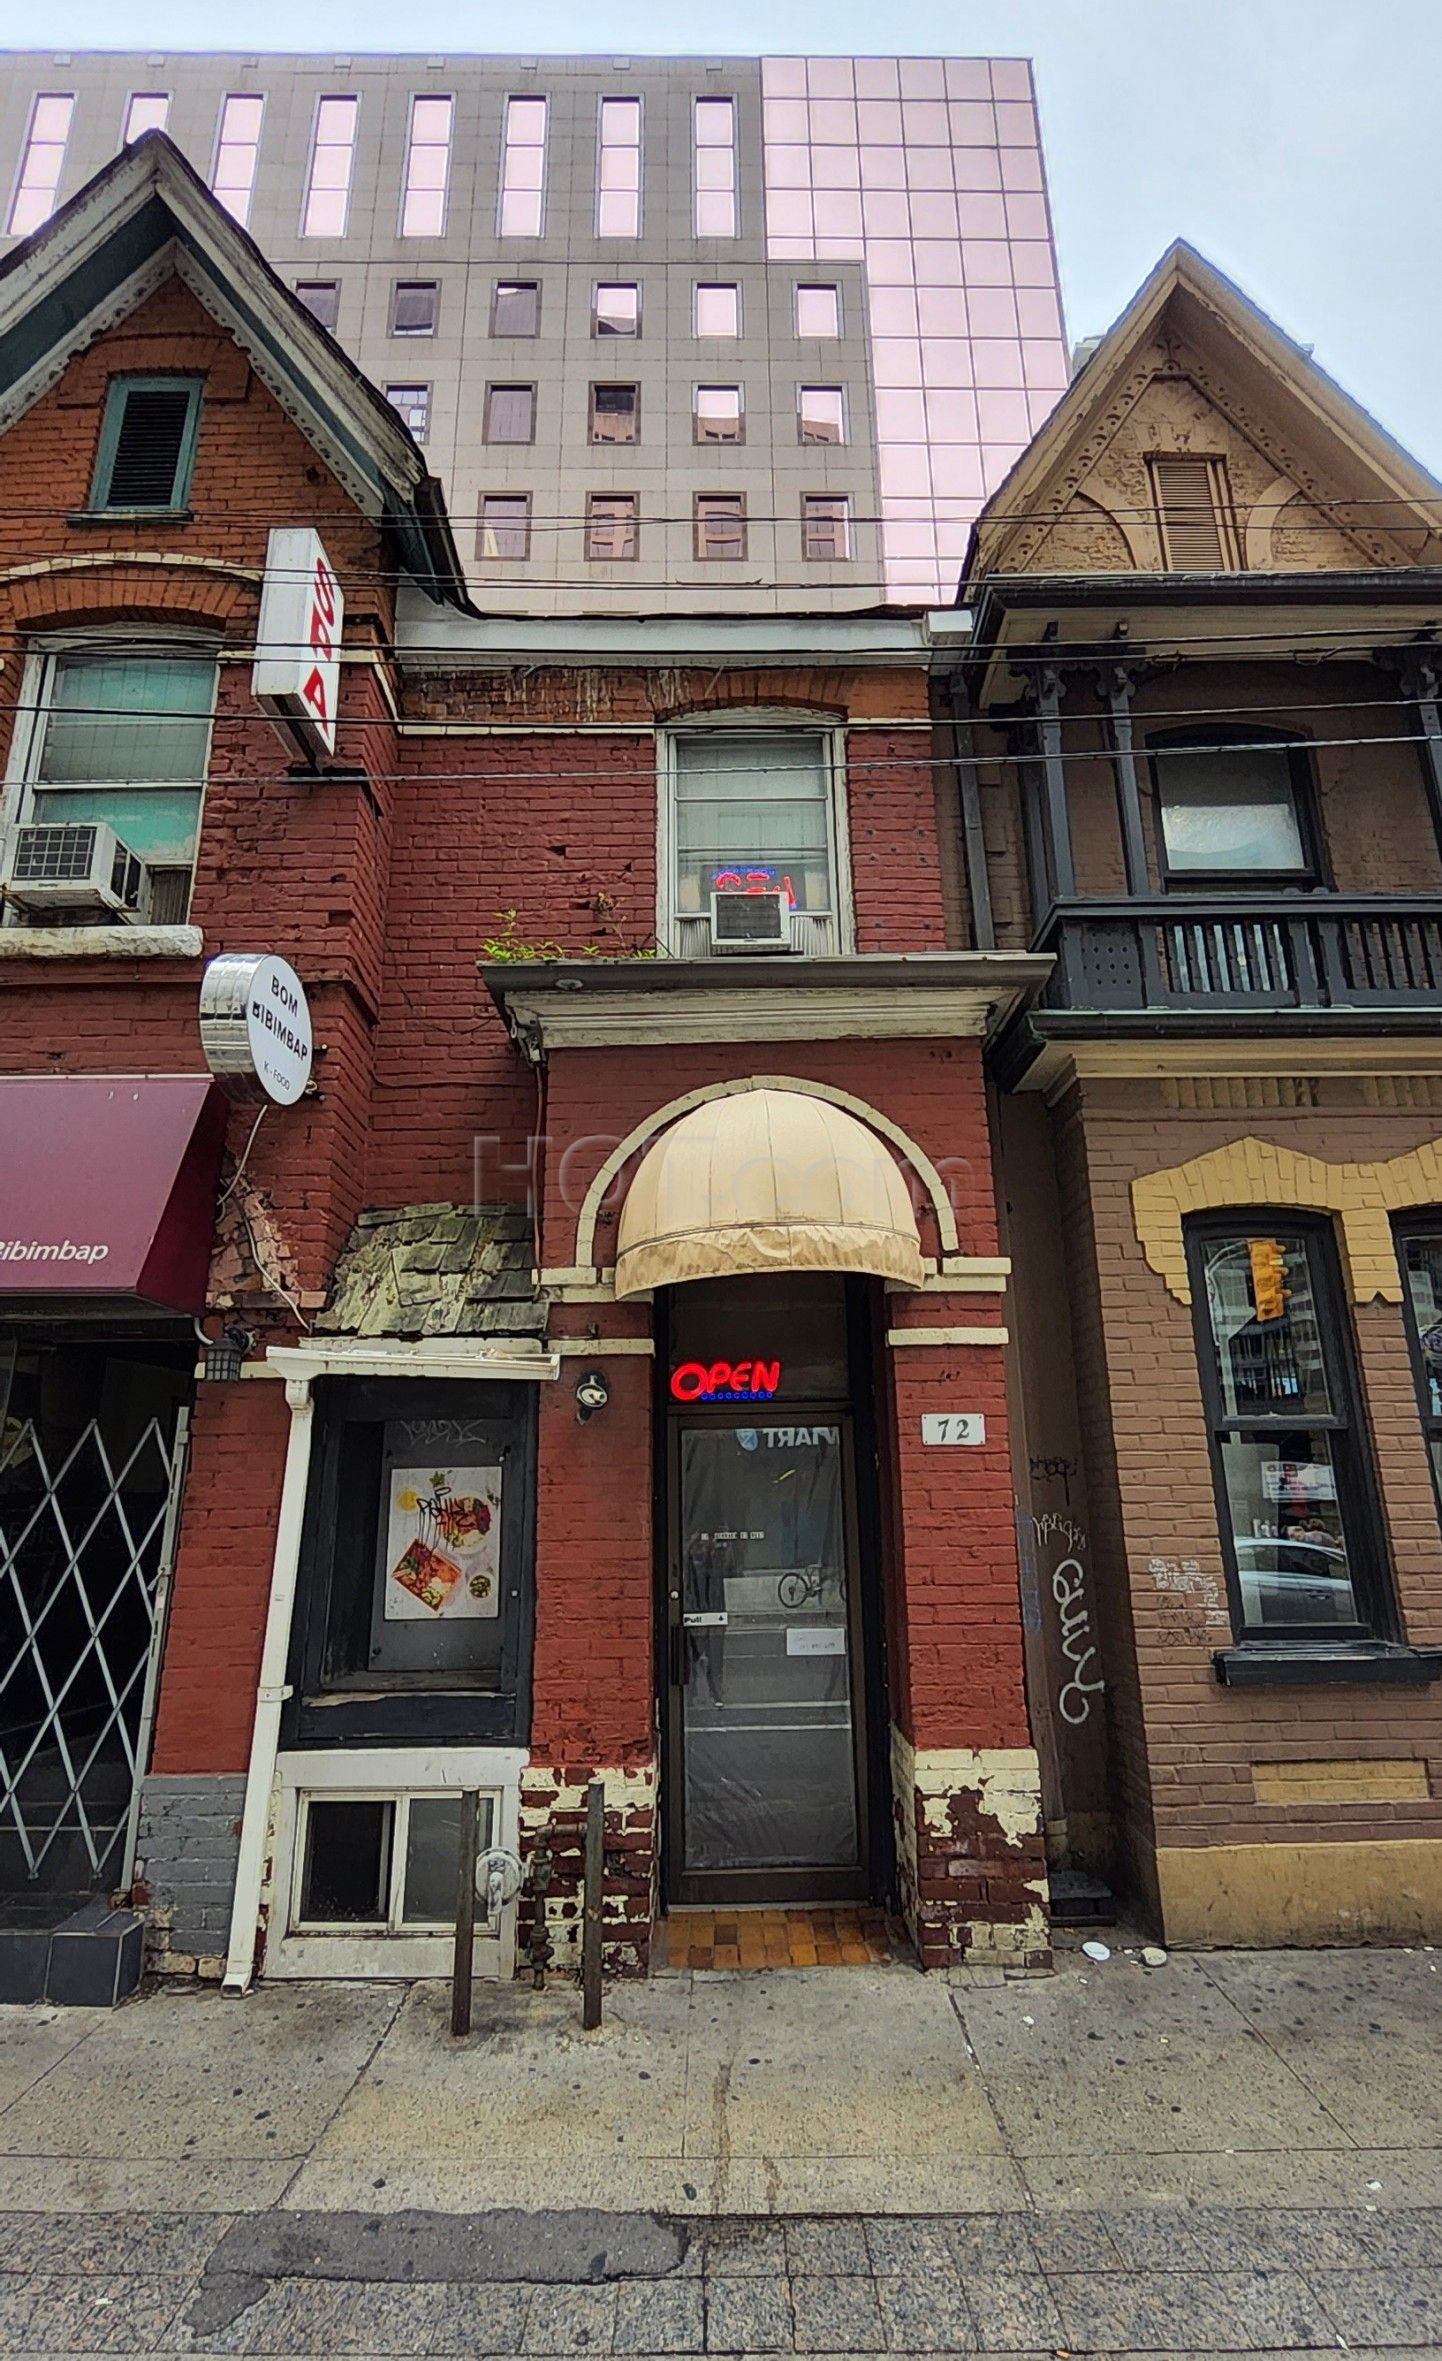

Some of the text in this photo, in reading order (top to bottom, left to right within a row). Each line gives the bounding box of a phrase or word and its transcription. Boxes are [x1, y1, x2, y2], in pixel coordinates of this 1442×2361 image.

[302, 557, 335, 740] SPA
[271, 975, 298, 1018] BOM
[252, 1001, 308, 1062] BIBIMBAP
[670, 1361, 781, 1401] OPEN
[937, 1418, 970, 1442] 72
